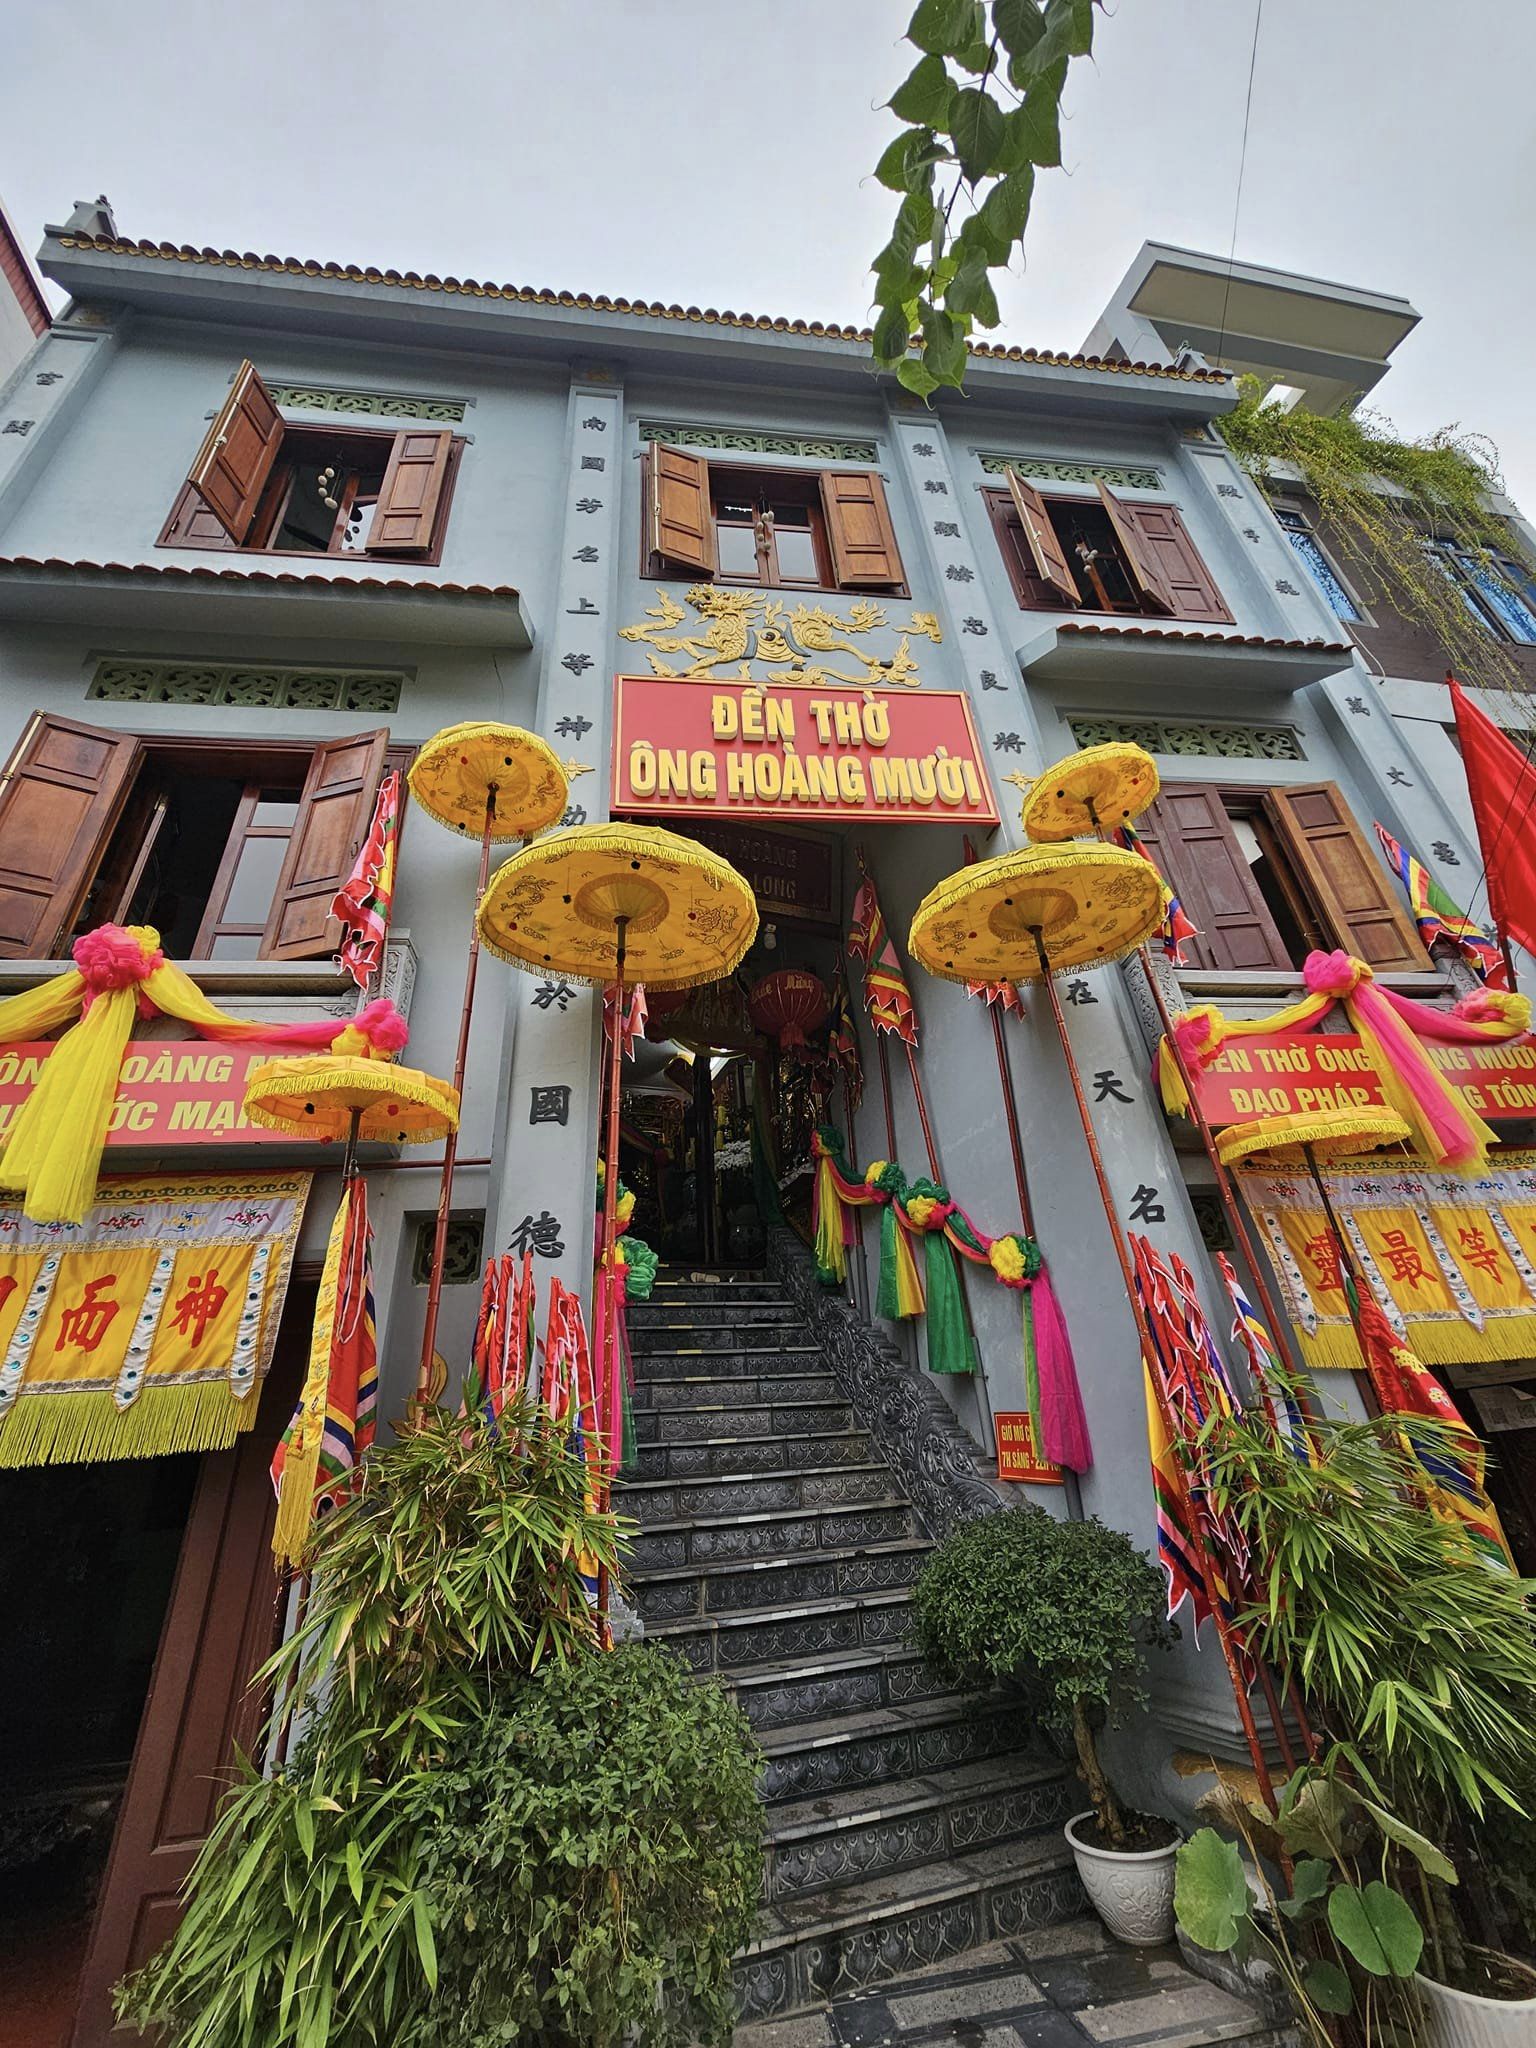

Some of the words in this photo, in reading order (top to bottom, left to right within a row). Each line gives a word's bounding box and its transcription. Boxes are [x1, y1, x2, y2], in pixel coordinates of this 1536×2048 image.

[554, 415, 608, 742] 南國芳名上等神
[711, 683, 796, 742] ĐỀN
[809, 690, 891, 747] THỜ
[629, 740, 717, 799] ÔNG
[726, 742, 867, 804] HOÀNG
[869, 746, 982, 806] MƯỜI
[119, 1050, 234, 1084] OÀNG
[1255, 1042, 1311, 1073] THỜ
[1315, 1043, 1371, 1073] ÔNG
[1065, 978, 1166, 1225] 在天名
[1229, 1087, 1292, 1119] ĐẠO
[1294, 1082, 1371, 1113] PHÁP
